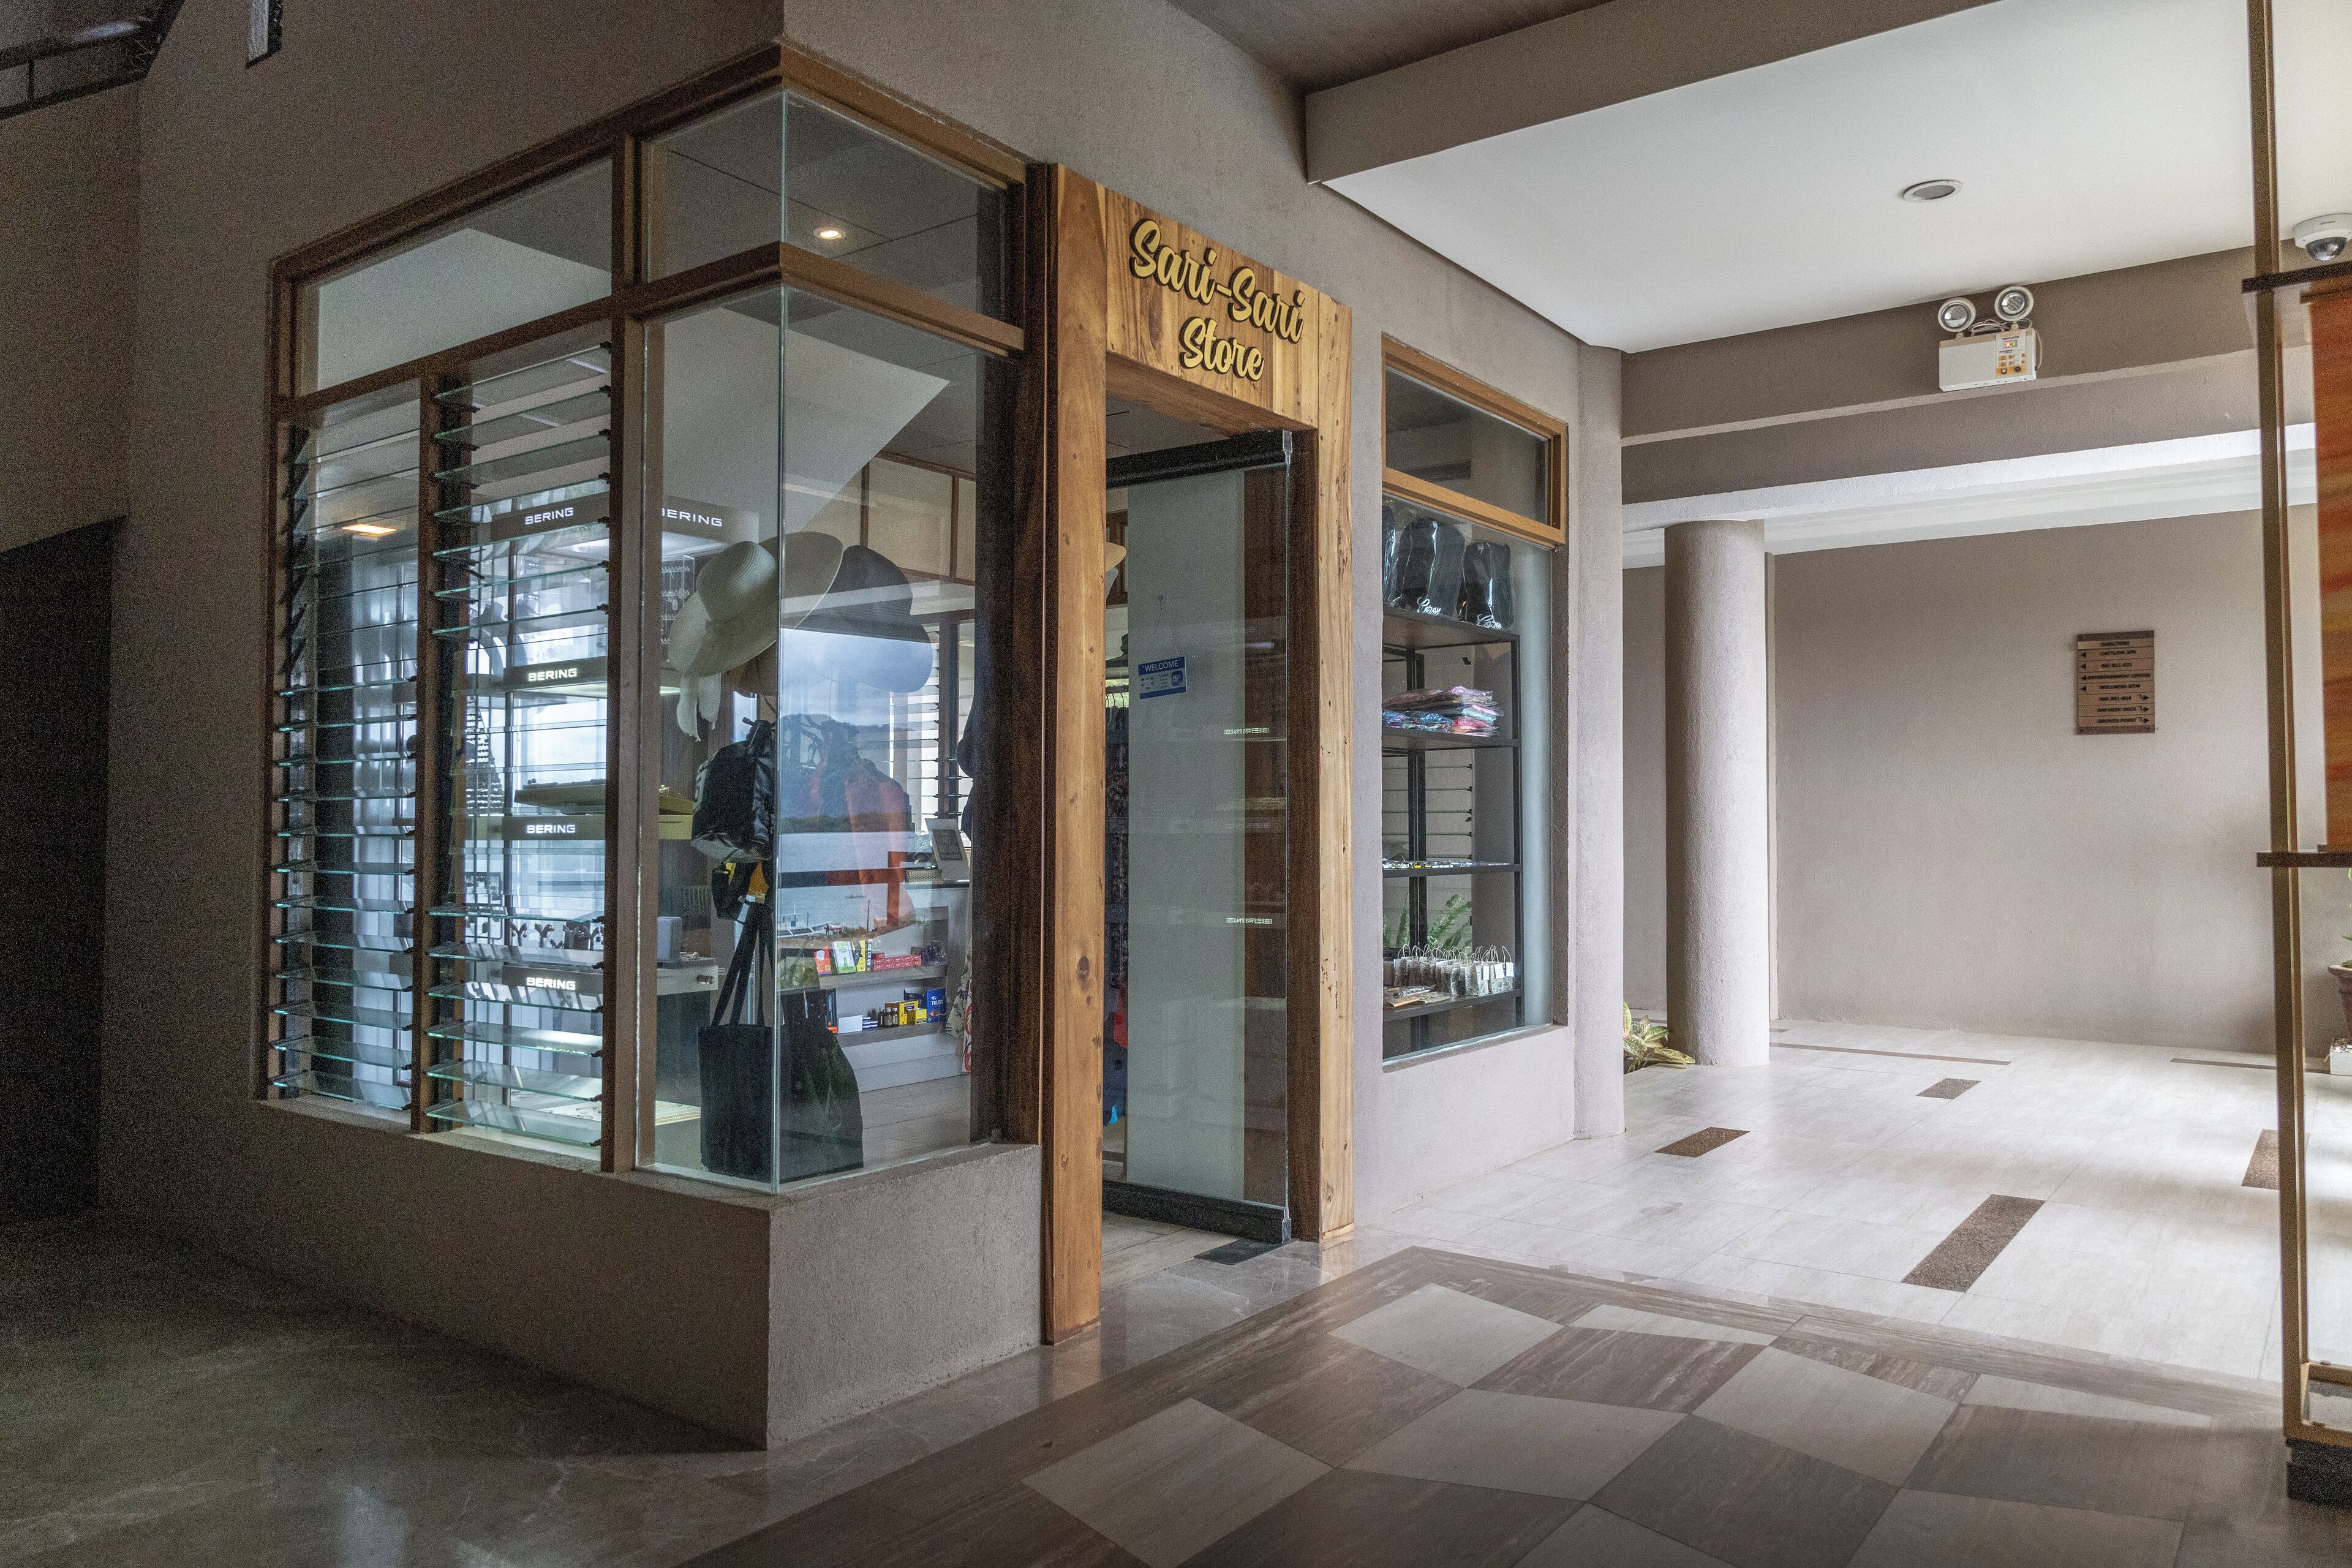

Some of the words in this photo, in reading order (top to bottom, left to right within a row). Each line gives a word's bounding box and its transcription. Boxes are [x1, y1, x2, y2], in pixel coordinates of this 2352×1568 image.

[1130, 219, 1305, 344] Sari-Sari
[1179, 317, 1264, 382] Store
[526, 507, 574, 524] BERING
[1144, 660, 1178, 672] WELCOME
[528, 668, 578, 682] BERING
[526, 824, 576, 834] BERING
[526, 977, 576, 990] BERING
